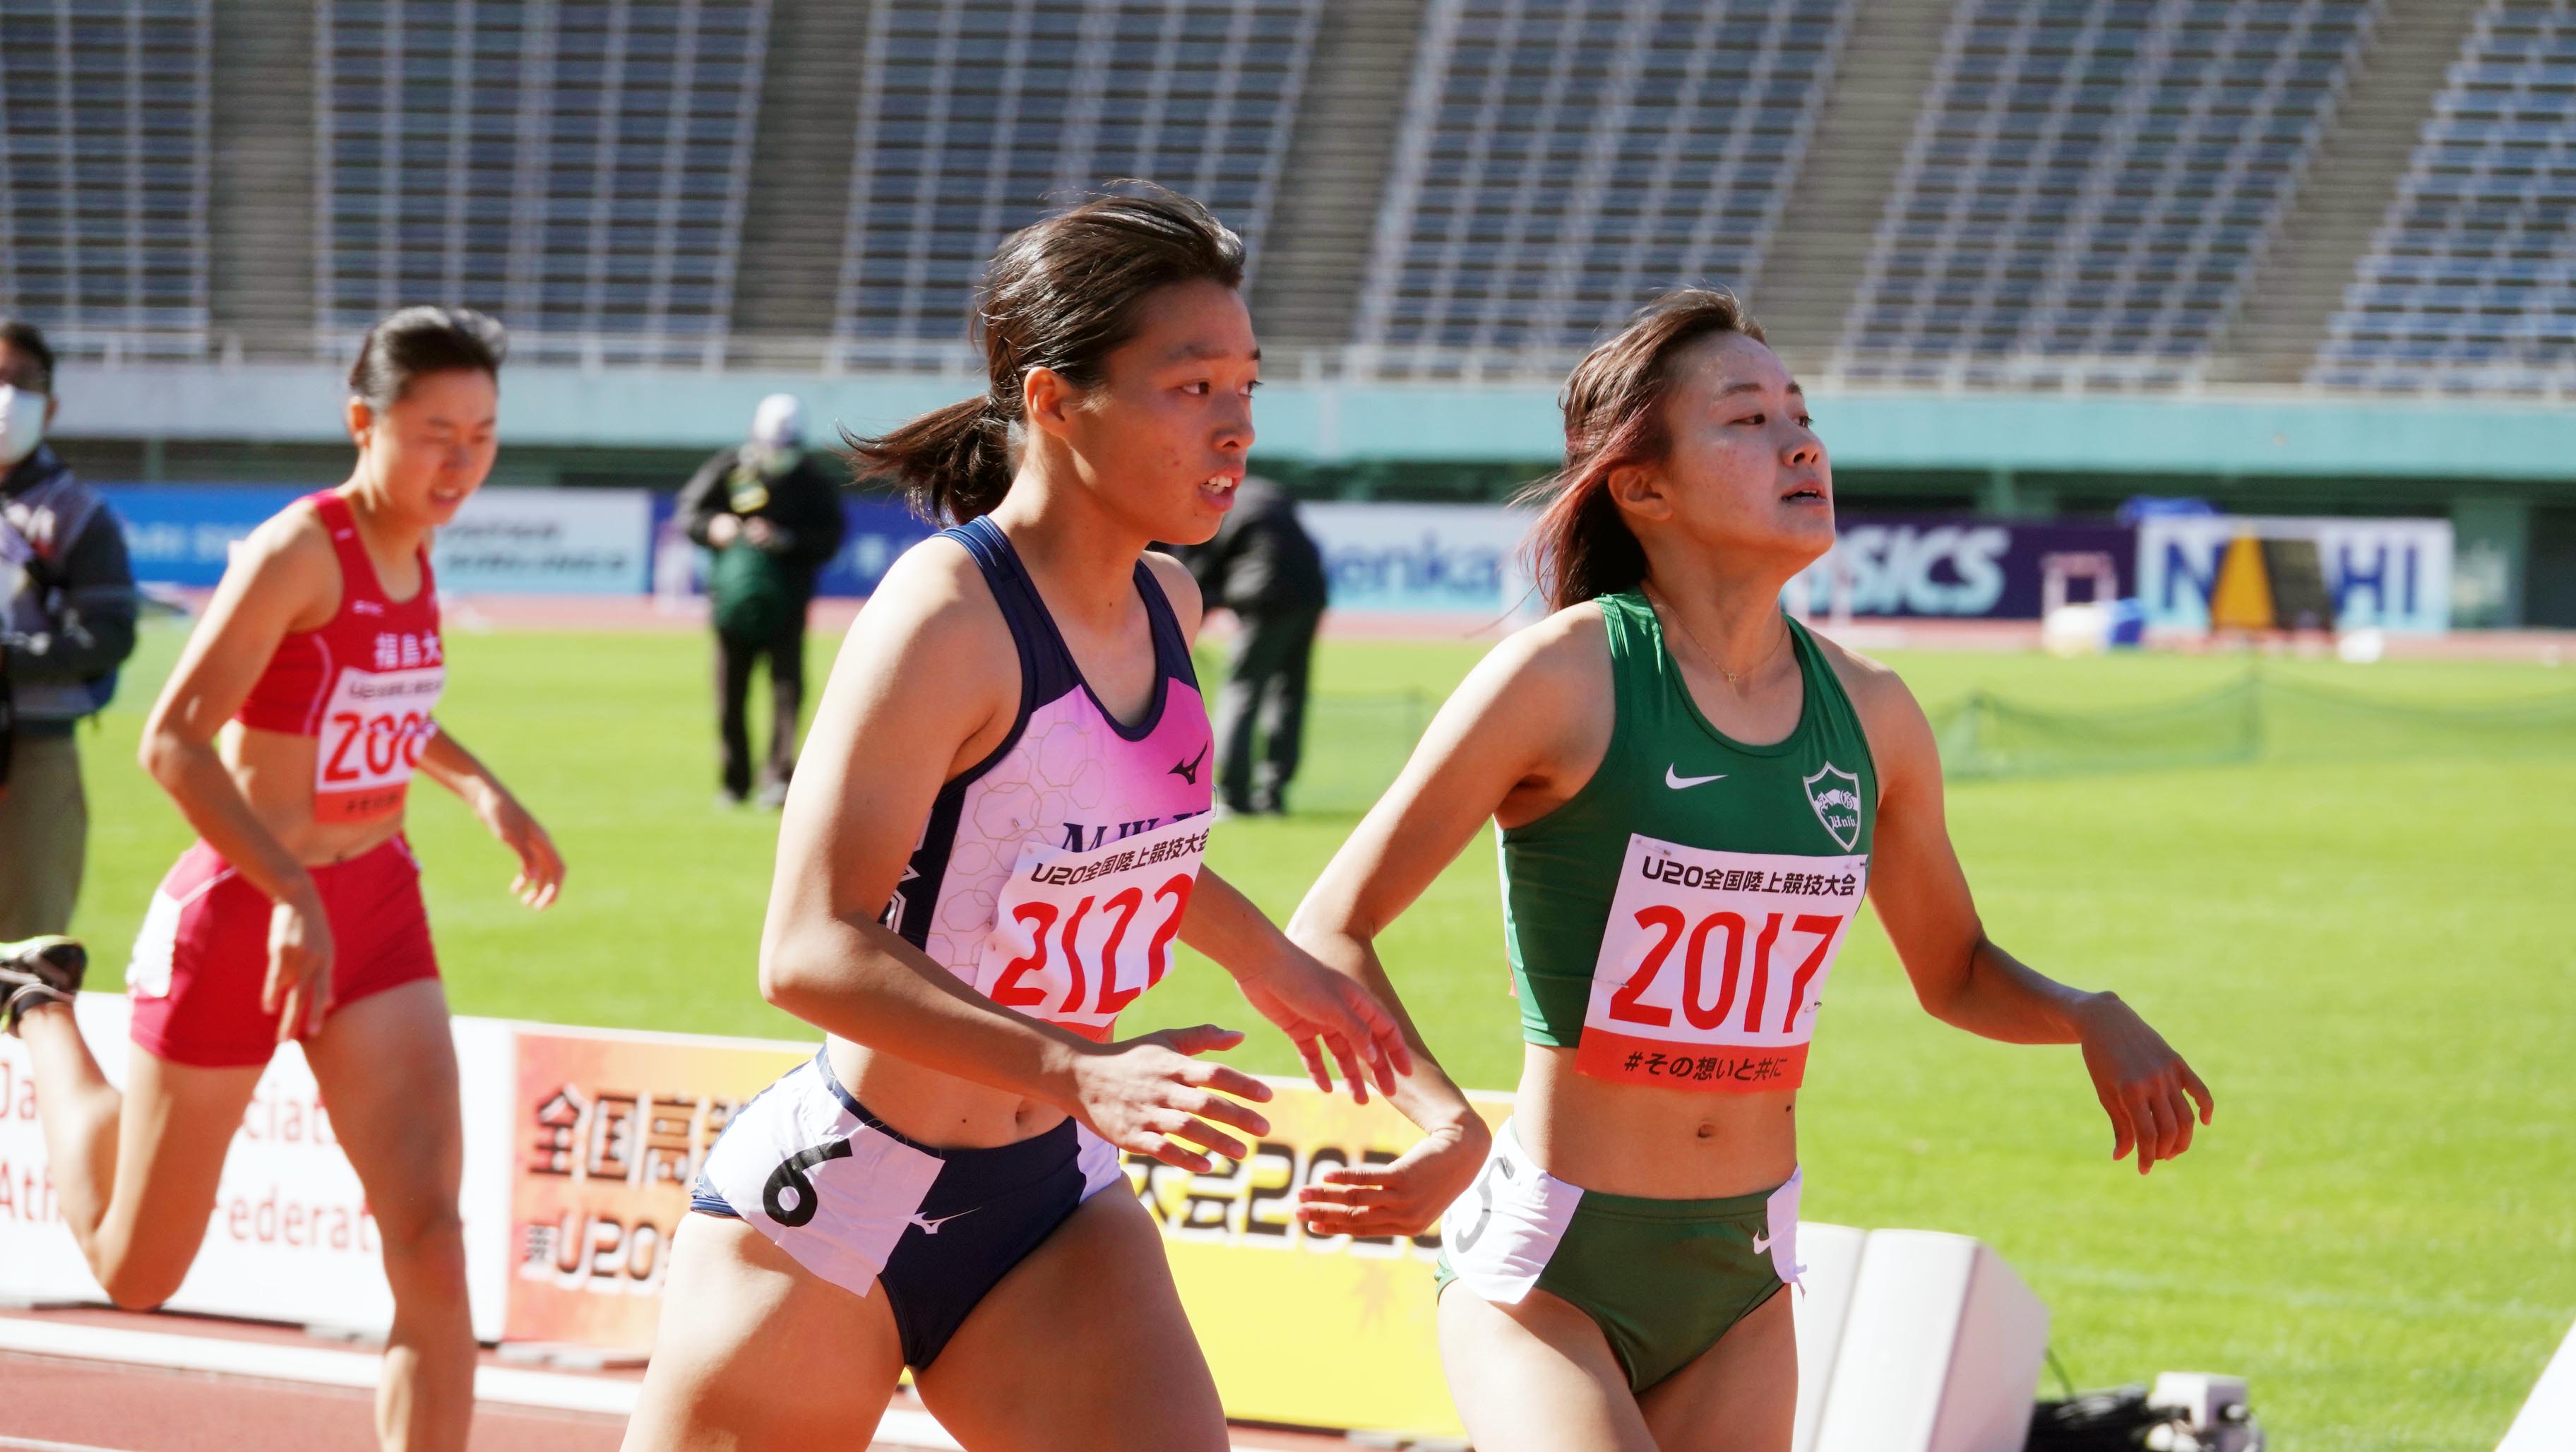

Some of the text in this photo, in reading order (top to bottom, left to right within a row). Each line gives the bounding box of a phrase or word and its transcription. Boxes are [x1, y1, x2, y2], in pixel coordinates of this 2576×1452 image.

[1030, 828, 1209, 886] U20全国陸上競技大会
[1642, 856, 1856, 896] U20全国陸上競技大会
[989, 873, 1193, 1014] 2122
[1609, 904, 1844, 1034] 2017
[1624, 1051, 1788, 1082] #その想いと共に
[763, 1137, 852, 1227] 6
[1455, 1155, 1516, 1254] 5
